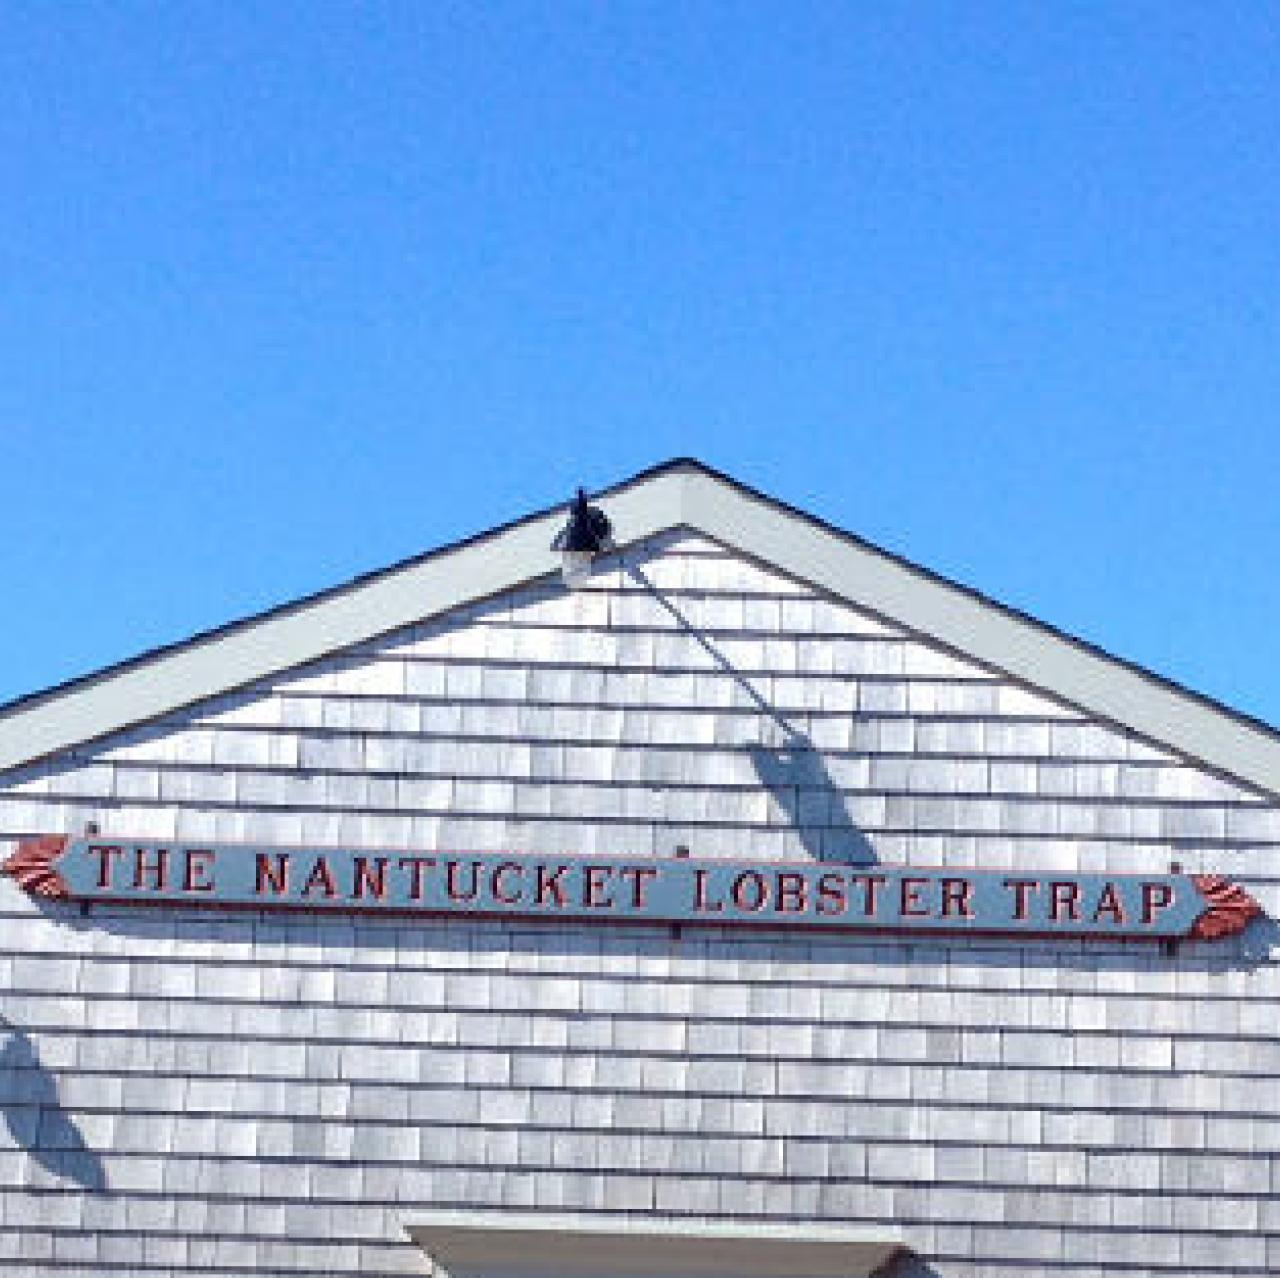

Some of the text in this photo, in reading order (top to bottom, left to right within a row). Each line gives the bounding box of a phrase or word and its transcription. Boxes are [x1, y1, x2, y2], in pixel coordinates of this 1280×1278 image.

[87, 845, 1174, 924] THE NANTUCKET LOBSTER TRAP
